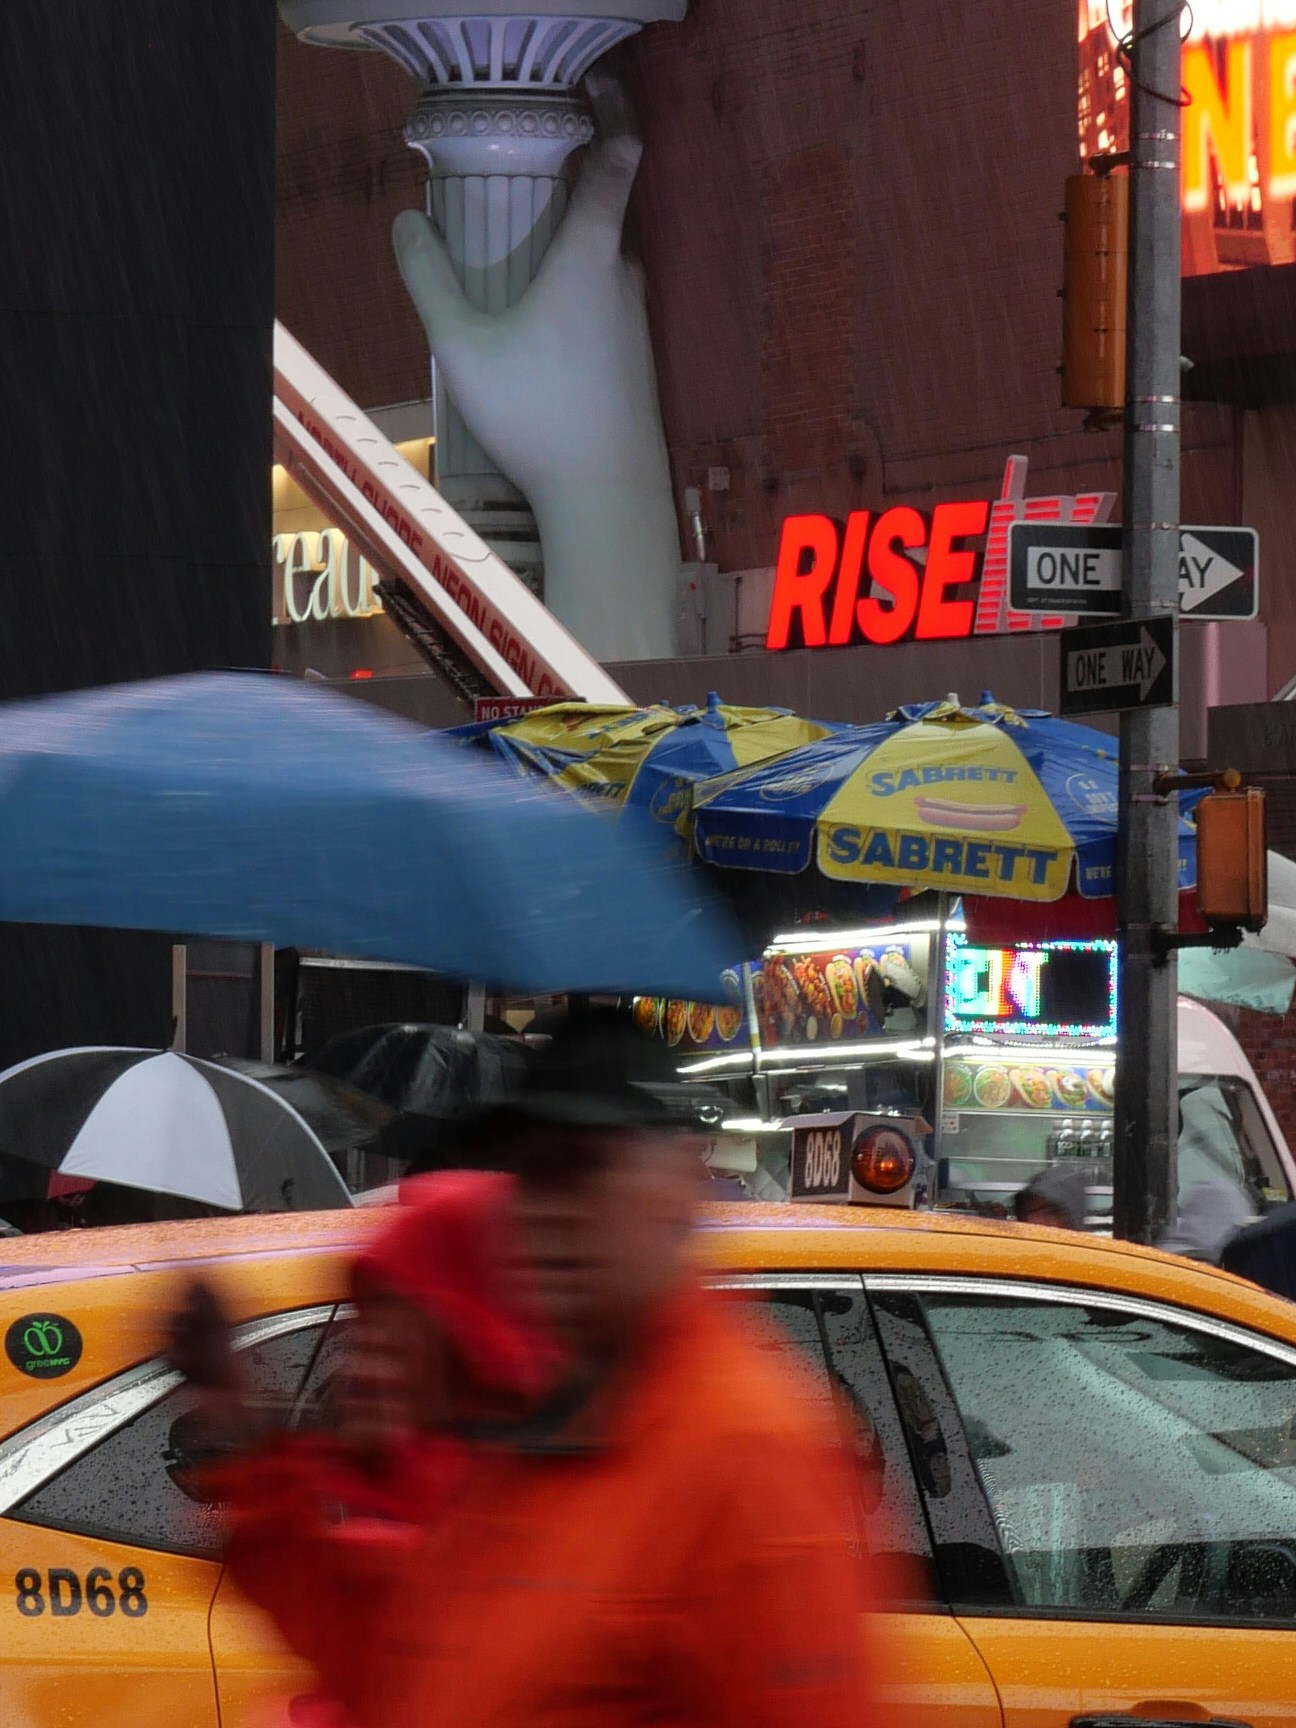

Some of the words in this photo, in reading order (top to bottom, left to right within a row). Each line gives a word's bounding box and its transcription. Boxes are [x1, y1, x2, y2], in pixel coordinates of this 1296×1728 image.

[766, 499, 991, 651] RISE
[1036, 552, 1101, 586] ONE
[1179, 556, 1214, 589] AY
[431, 553, 486, 633] NEON
[488, 623, 538, 692] SIGN
[1075, 652, 1107, 688] ONE
[1121, 645, 1156, 681] WAY
[481, 706, 500, 721] NO
[869, 764, 1018, 798] SABRETT
[828, 828, 1059, 886] SABRETT
[804, 1130, 841, 1189] 8D68
[14, 1566, 149, 1618] 8D68
